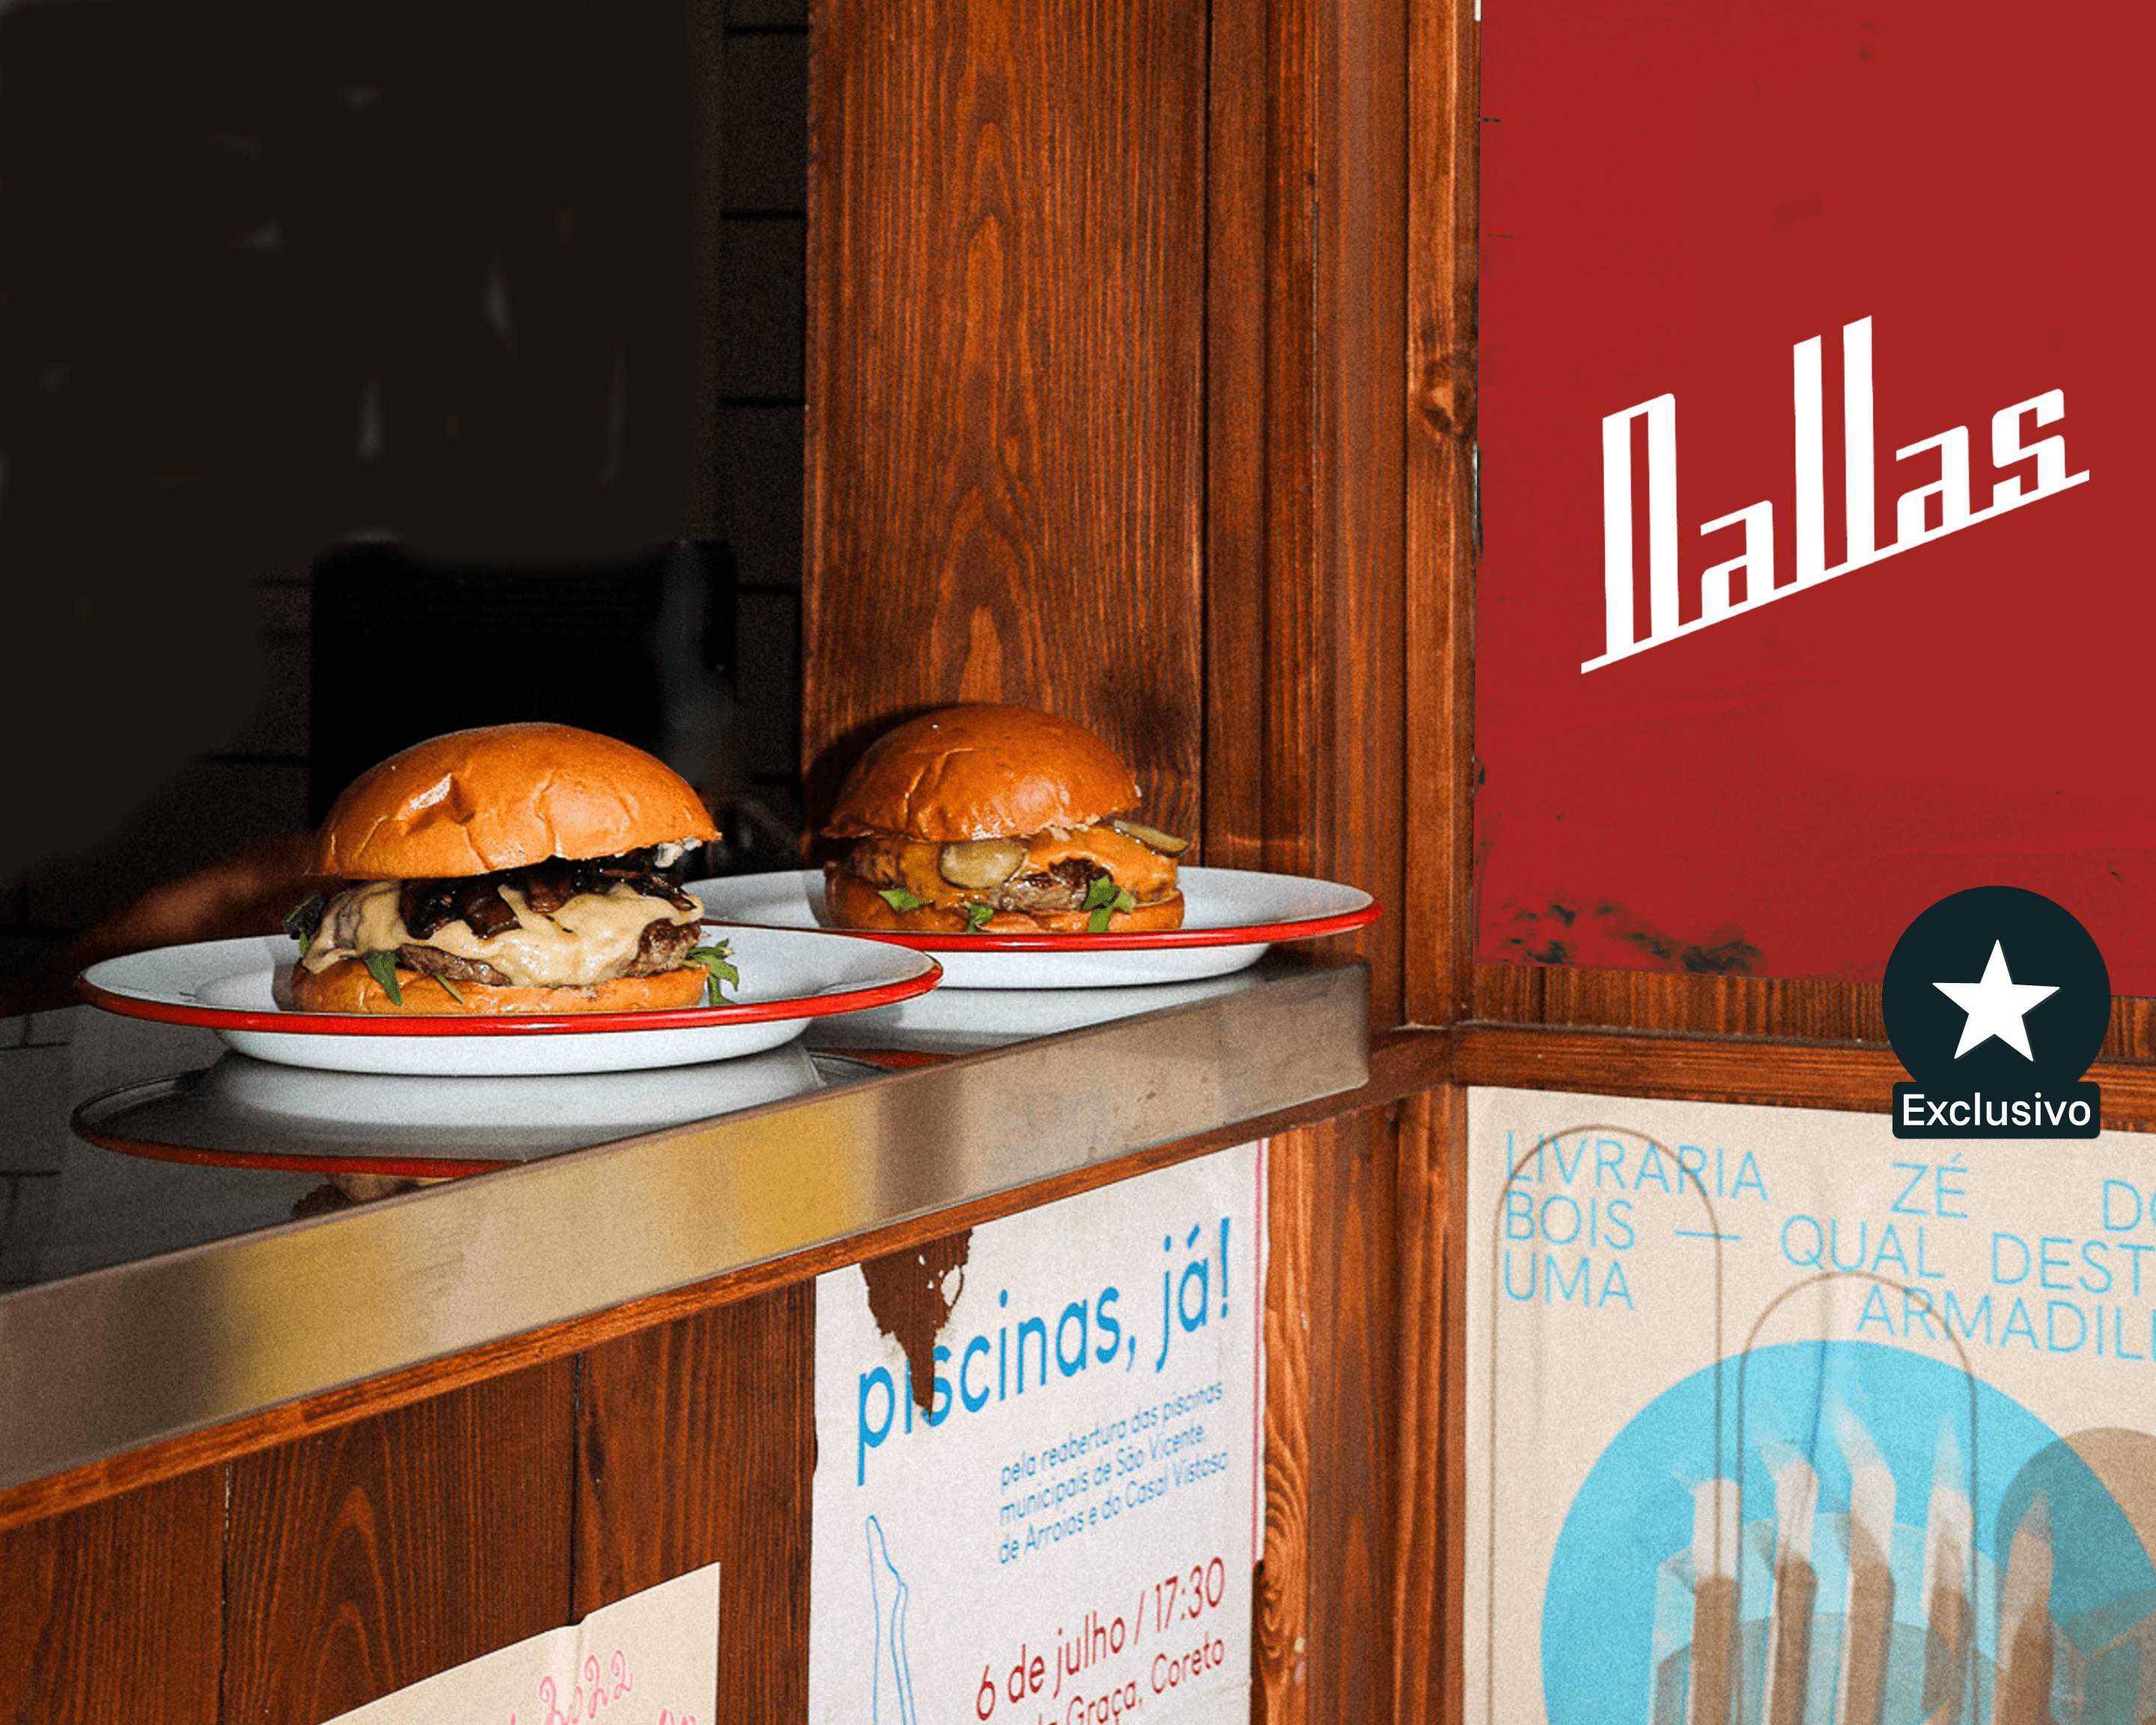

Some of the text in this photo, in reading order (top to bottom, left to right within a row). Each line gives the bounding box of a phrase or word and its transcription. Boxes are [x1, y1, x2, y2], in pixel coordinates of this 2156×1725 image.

[1506, 1131, 2156, 1232] LIVRARIA ZÉ D
[1505, 1191, 1638, 1251] BOIS
[1781, 1214, 1946, 1280] QUAL
[856, 1217, 1231, 1487] piscinas, já!
[1503, 1250, 2156, 1362] UMA ARMADIL
[999, 1470, 1089, 1526] municipais
[1092, 1457, 1112, 1487] de
[1116, 1445, 1145, 1476] São
[1000, 1381, 1223, 1494] pela reabertura das piscinas
[999, 1534, 1020, 1564] de
[1023, 1509, 1085, 1555] Arroios
[1088, 1505, 1098, 1526] e
[1101, 1488, 1122, 1520] do
[1125, 1466, 1169, 1509] Casal
[976, 1666, 996, 1721] 6
[1008, 1643, 1045, 1704] de
[1053, 1610, 1126, 1700] julho
[1154, 1557, 1225, 1632] 17:30
[1151, 1631, 1225, 1694] Coreto
